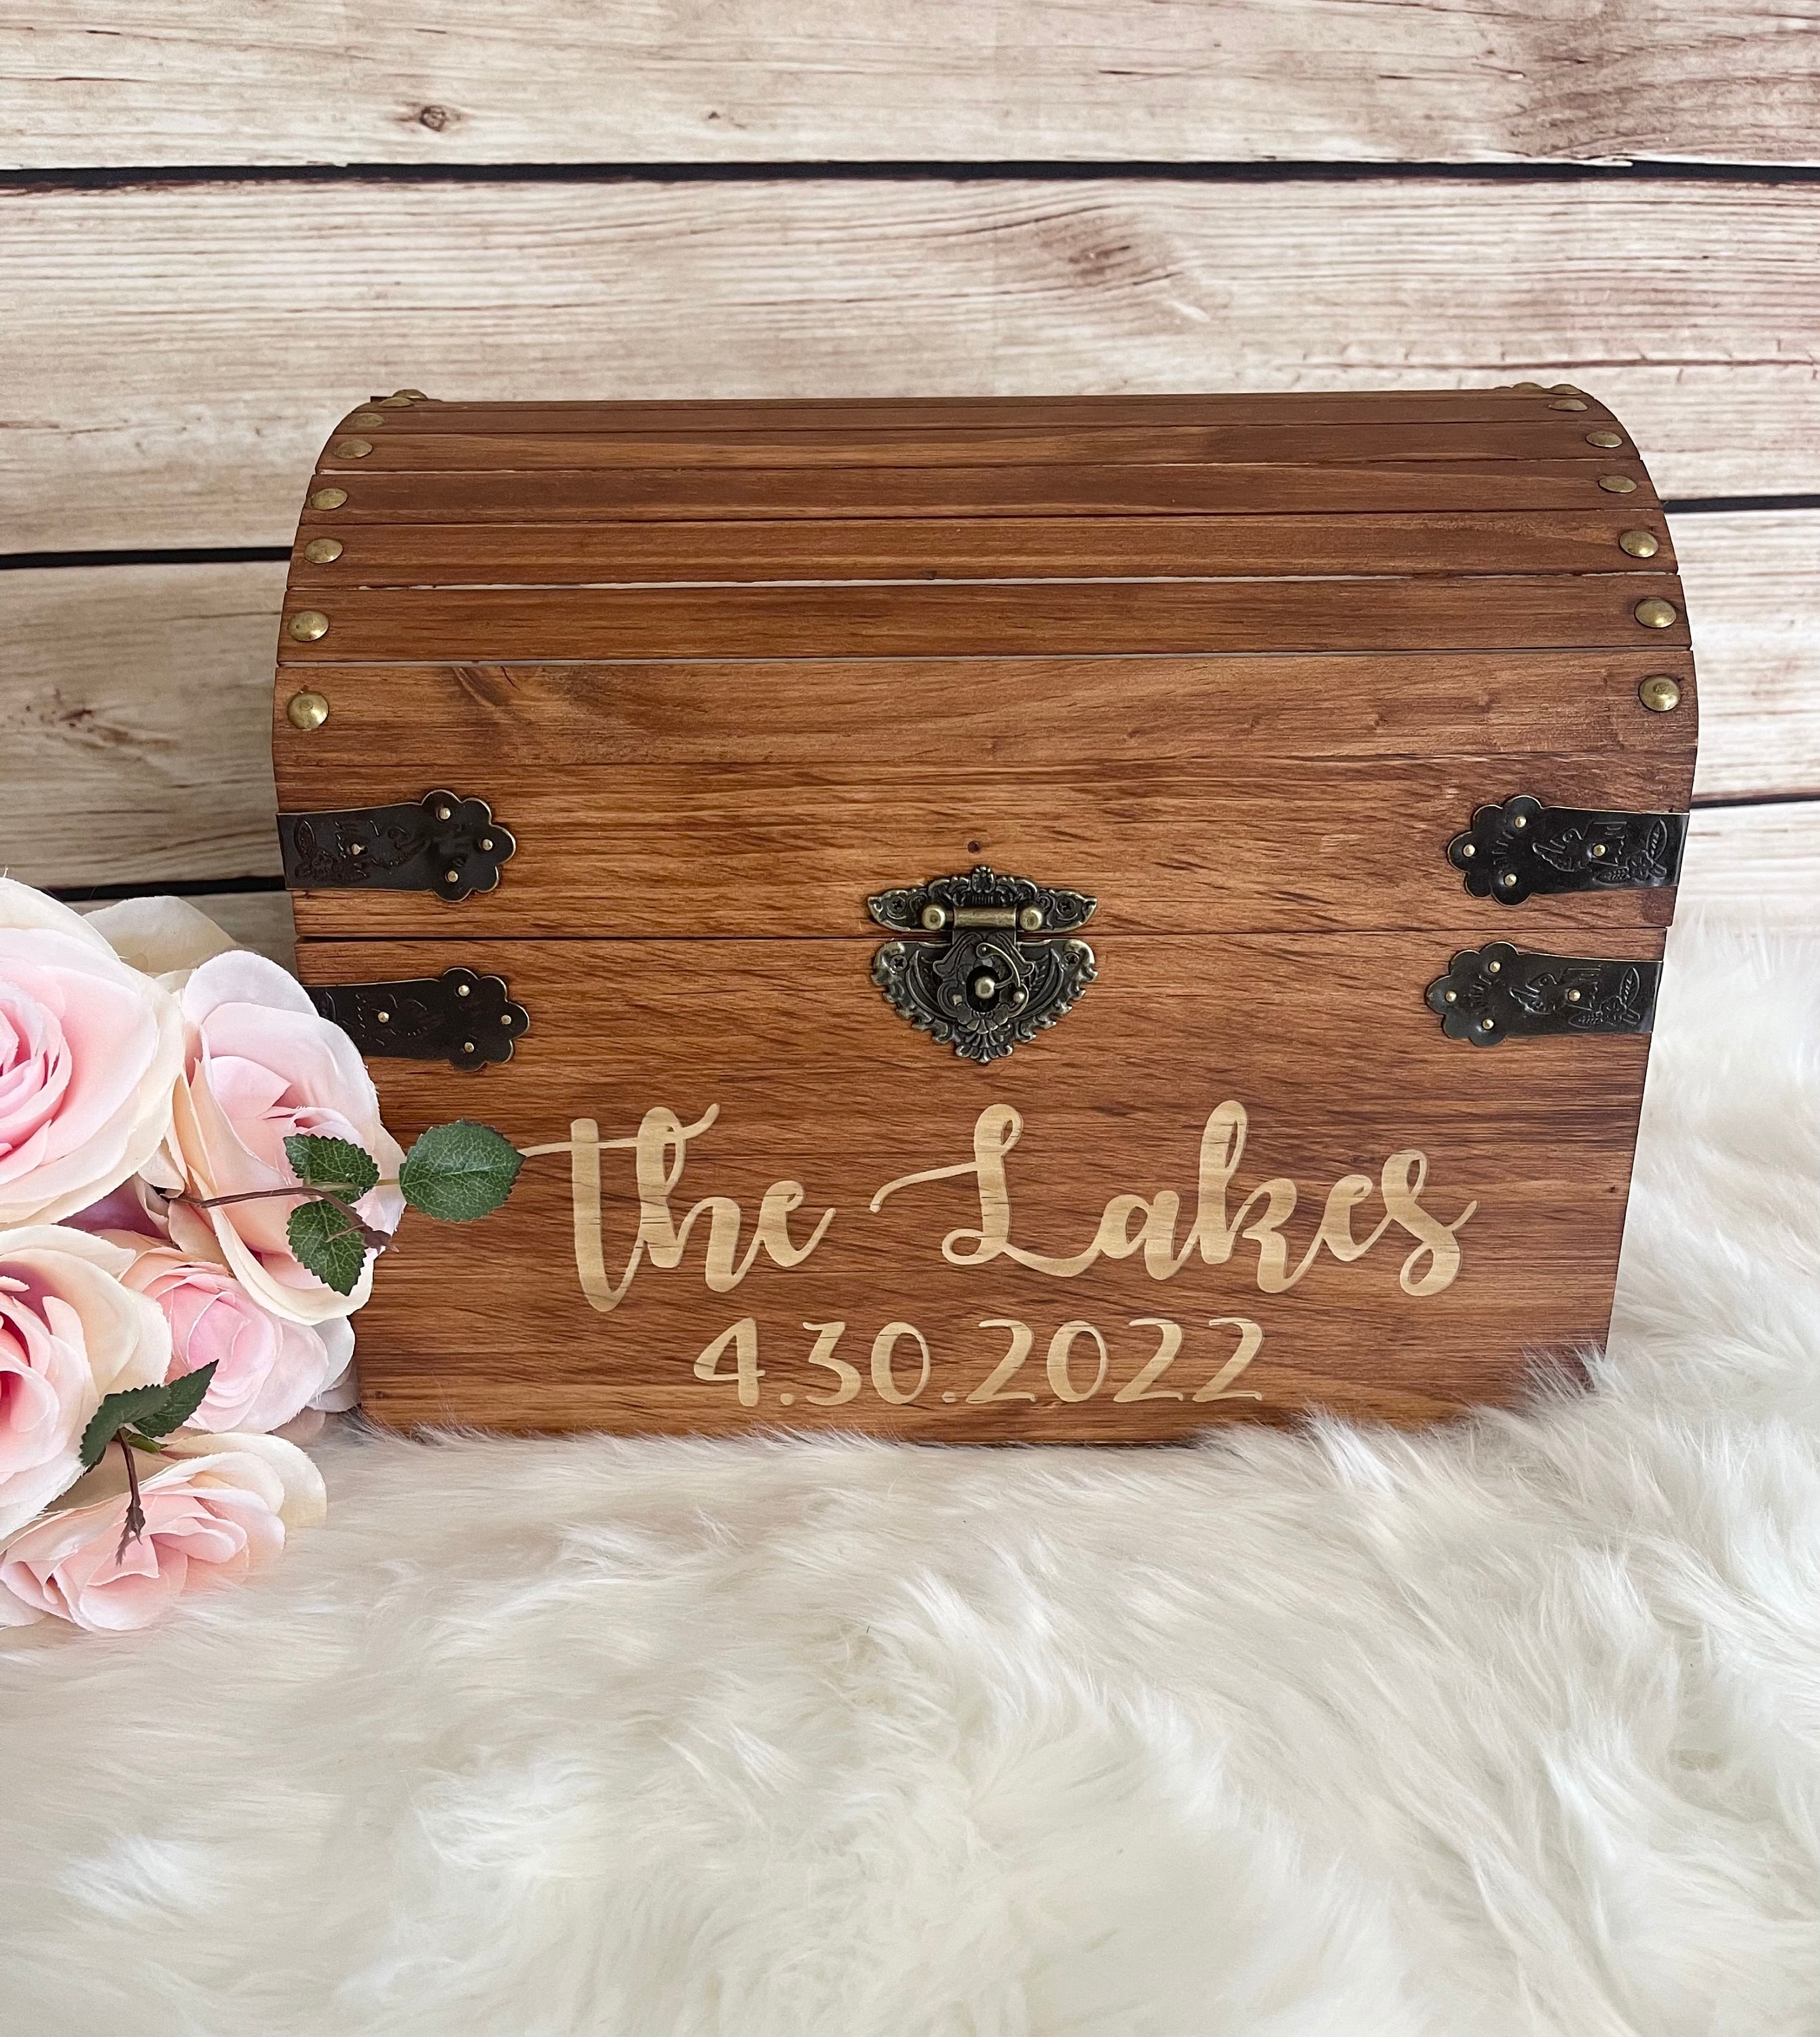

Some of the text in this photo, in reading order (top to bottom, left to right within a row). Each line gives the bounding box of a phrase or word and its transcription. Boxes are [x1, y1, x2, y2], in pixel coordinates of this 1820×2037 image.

[519, 1100, 1479, 1311] the Lakes
[692, 1317, 1263, 1407] 4.30.2022
